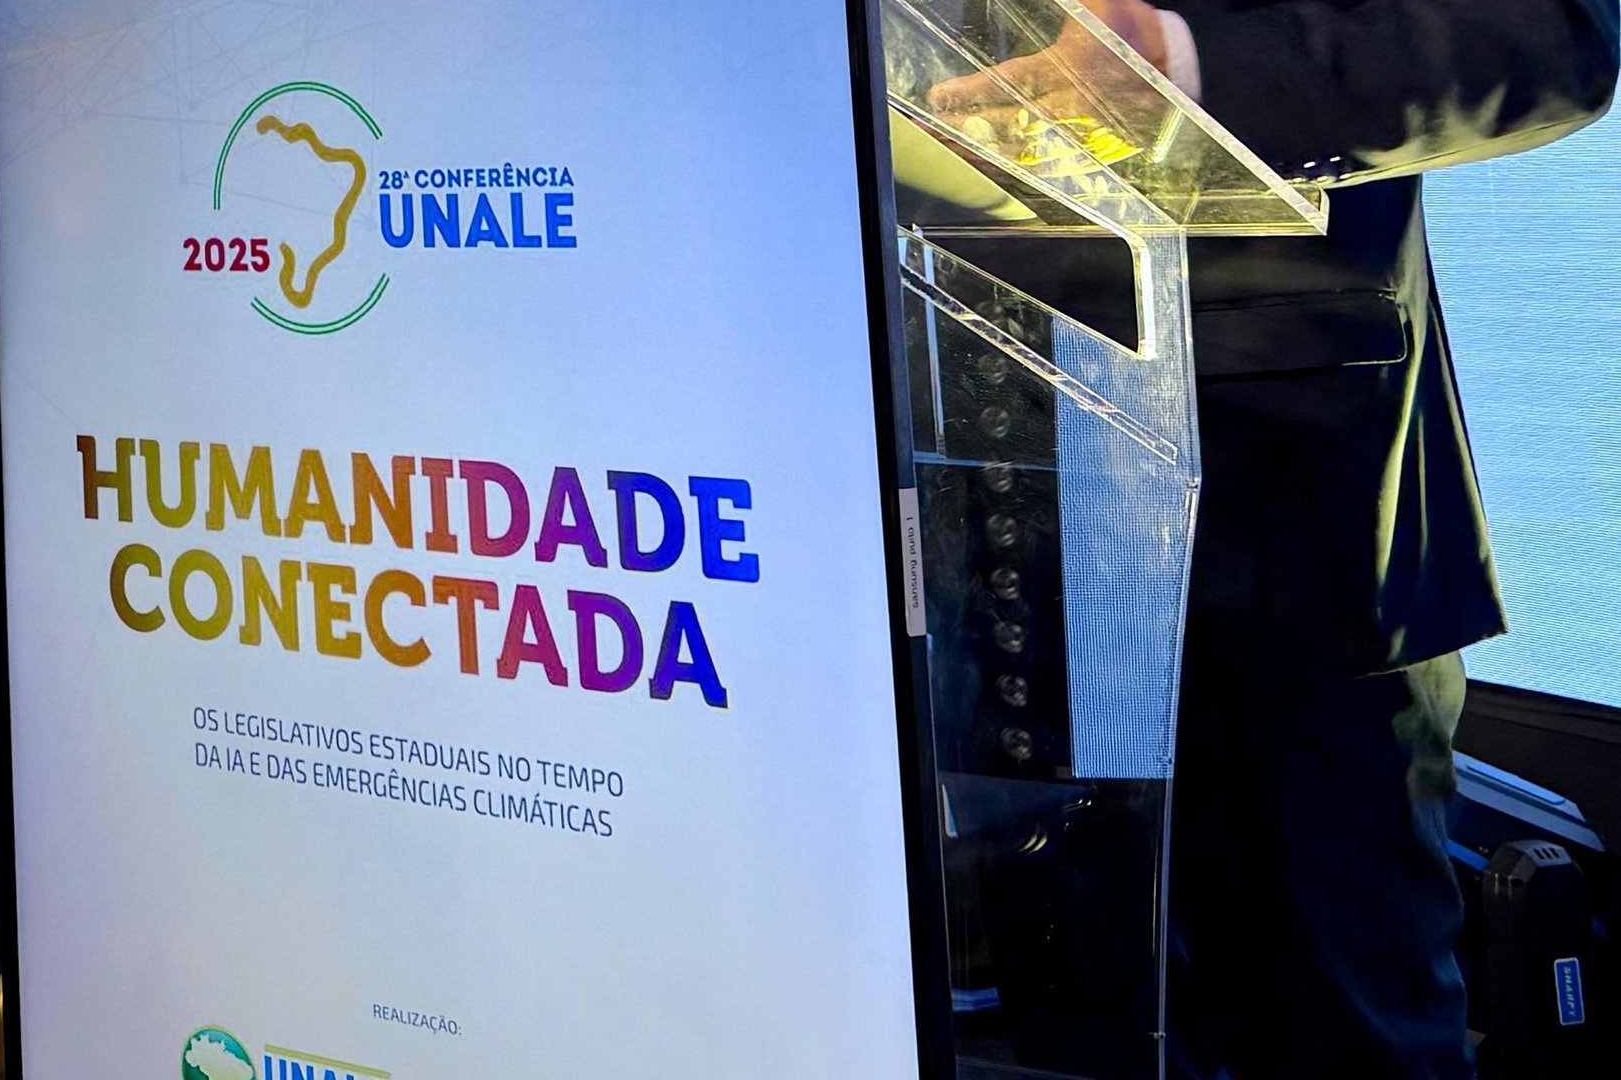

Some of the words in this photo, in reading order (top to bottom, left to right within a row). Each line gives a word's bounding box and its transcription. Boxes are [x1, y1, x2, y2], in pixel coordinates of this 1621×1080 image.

[414, 161, 575, 189] CONFERÊNCIA
[182, 237, 271, 273] 2025
[378, 191, 578, 249] UNALE
[76, 434, 761, 584] HUMANIDADE
[109, 544, 729, 708] CONECTADA
[193, 706, 219, 732] OS
[223, 710, 364, 755] LEGISLATIVOS
[369, 733, 491, 776] ESTADUAIS
[497, 752, 532, 783] NO
[535, 759, 624, 798] TEMPO
[194, 741, 223, 771] DA
[225, 746, 246, 774] IA
[249, 751, 262, 777] E
[266, 753, 308, 785] DAS
[312, 761, 467, 812] EMERGÊNCIAS
[473, 788, 613, 838] CLIMÁTICAS
[372, 1003, 462, 1037] REALIZAÇÃO:
